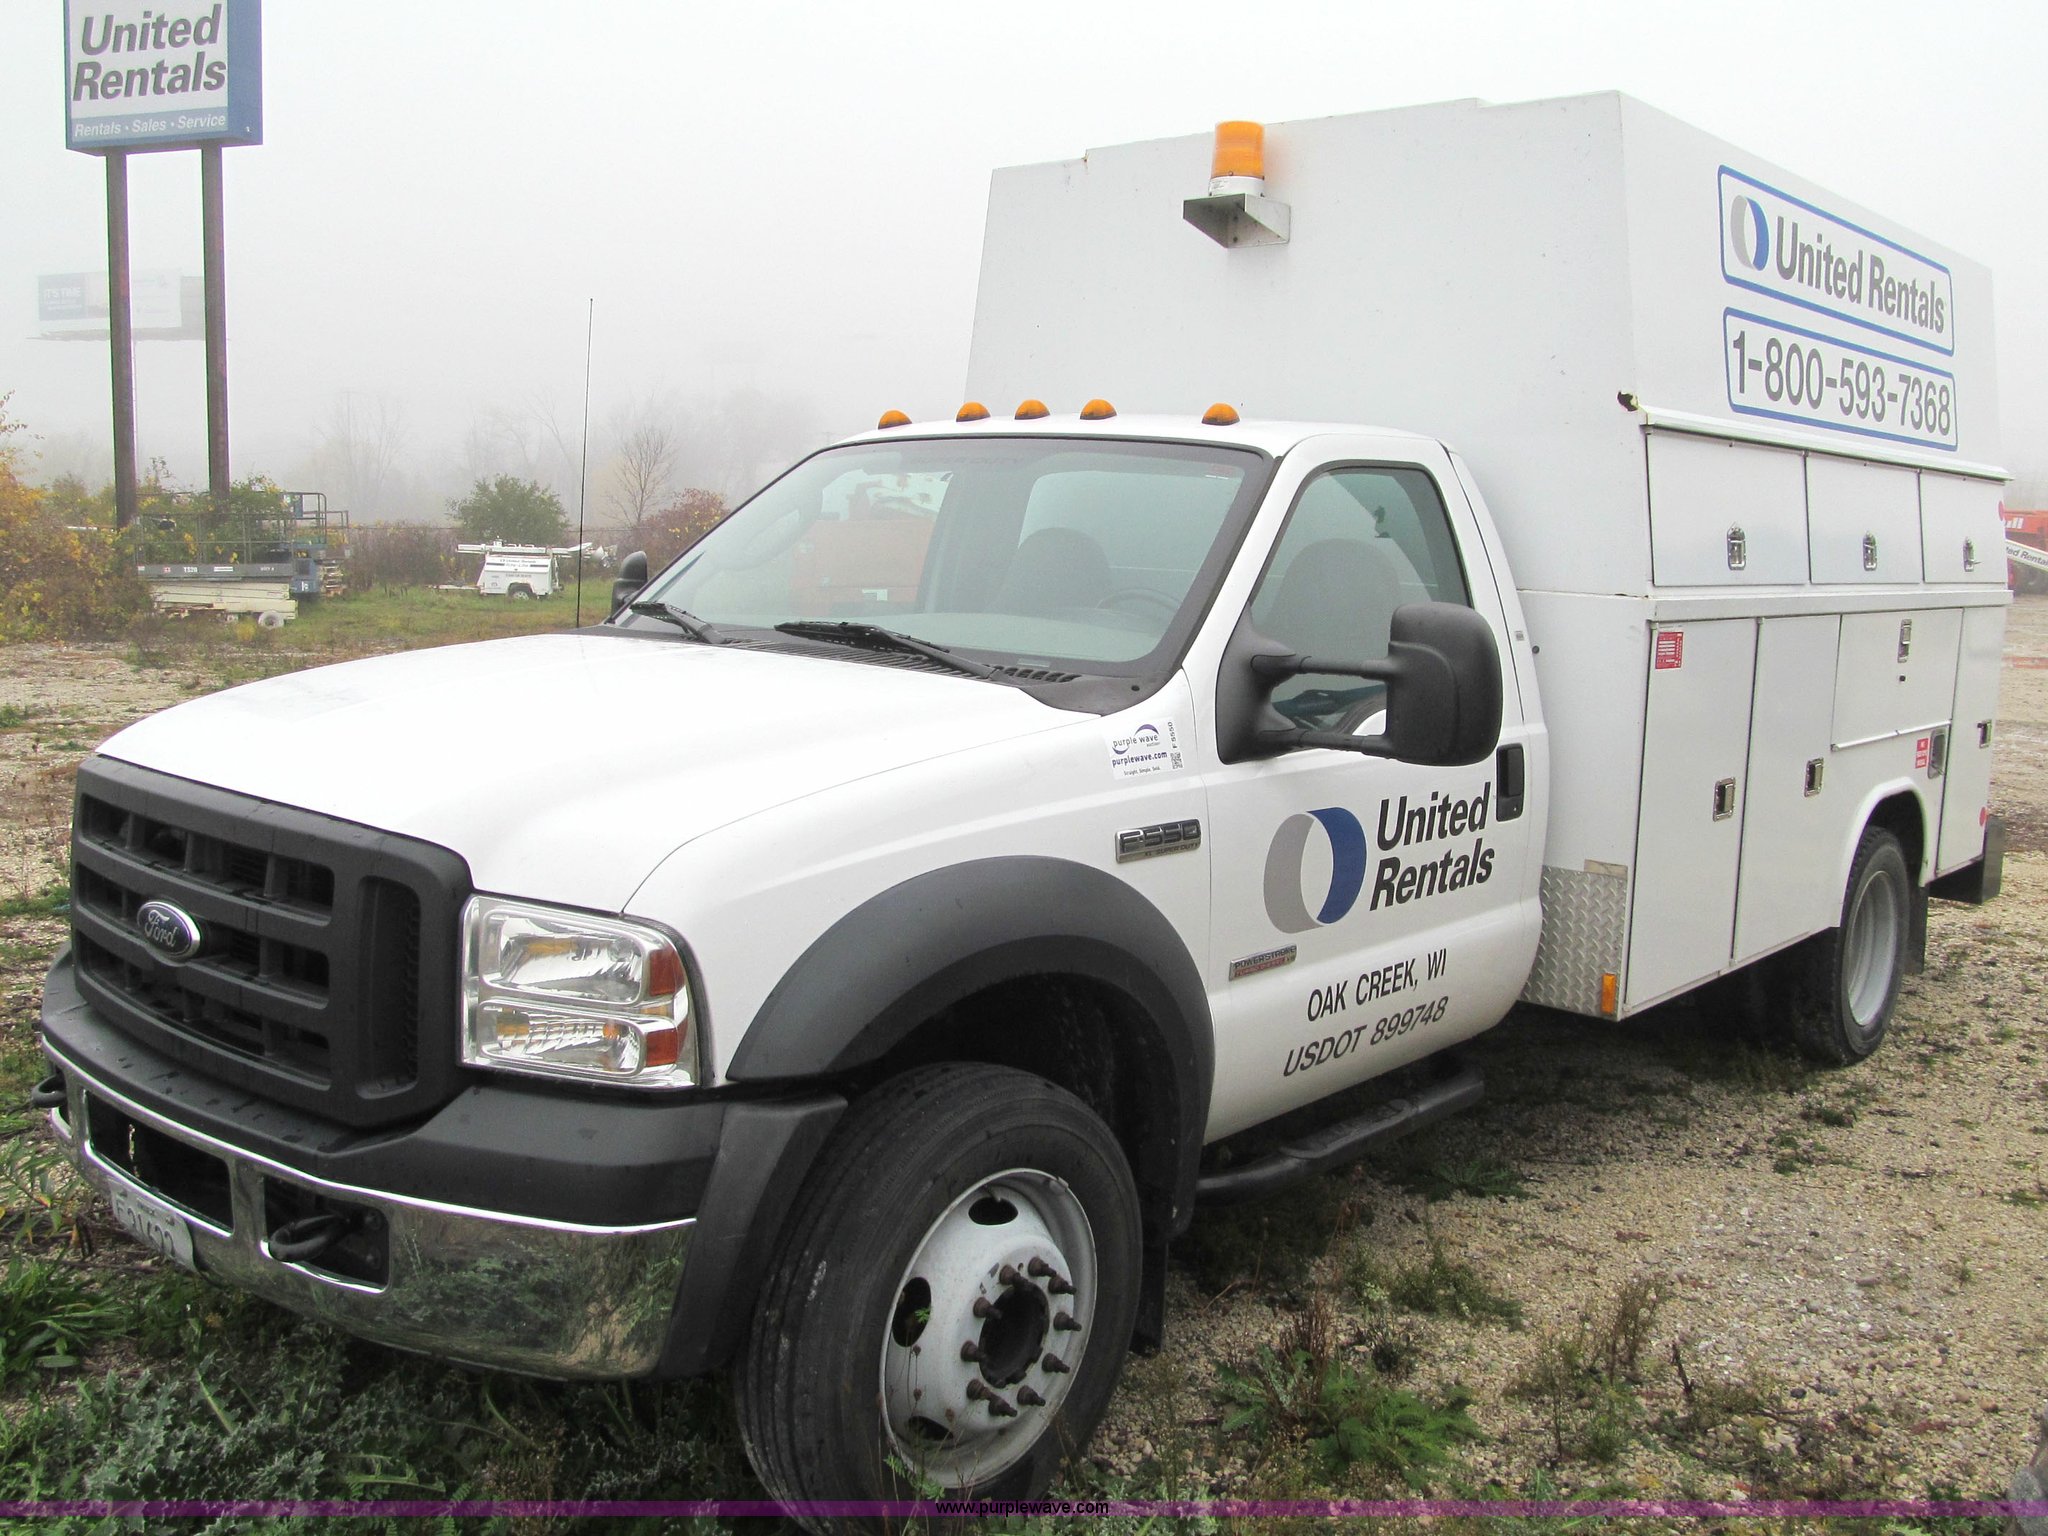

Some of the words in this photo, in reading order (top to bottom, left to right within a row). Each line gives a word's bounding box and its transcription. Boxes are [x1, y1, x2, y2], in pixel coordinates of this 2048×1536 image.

[81, 3, 223, 56] United
[72, 51, 227, 102] Rentals
[74, 121, 122, 138] Rentals
[131, 118, 167, 134] Sales
[177, 113, 226, 130] Service
[1775, 215, 1864, 305] United
[1868, 253, 1945, 335] Rentals
[1732, 329, 1951, 437] 1-800-593-7368
[1111, 751, 1168, 769] purplewave.com
[1112, 736, 1138, 748] purple
[1138, 734, 1159, 744] wave
[1377, 781, 1491, 851] United
[1369, 837, 1495, 912] Rentals
[144, 909, 178, 948] Ford
[1307, 979, 1348, 1022] OAK
[1355, 958, 1418, 1006] CREEK,
[1427, 948, 1447, 981] WI
[1283, 1024, 1368, 1077] USDOT
[1369, 995, 1449, 1046] 899748
